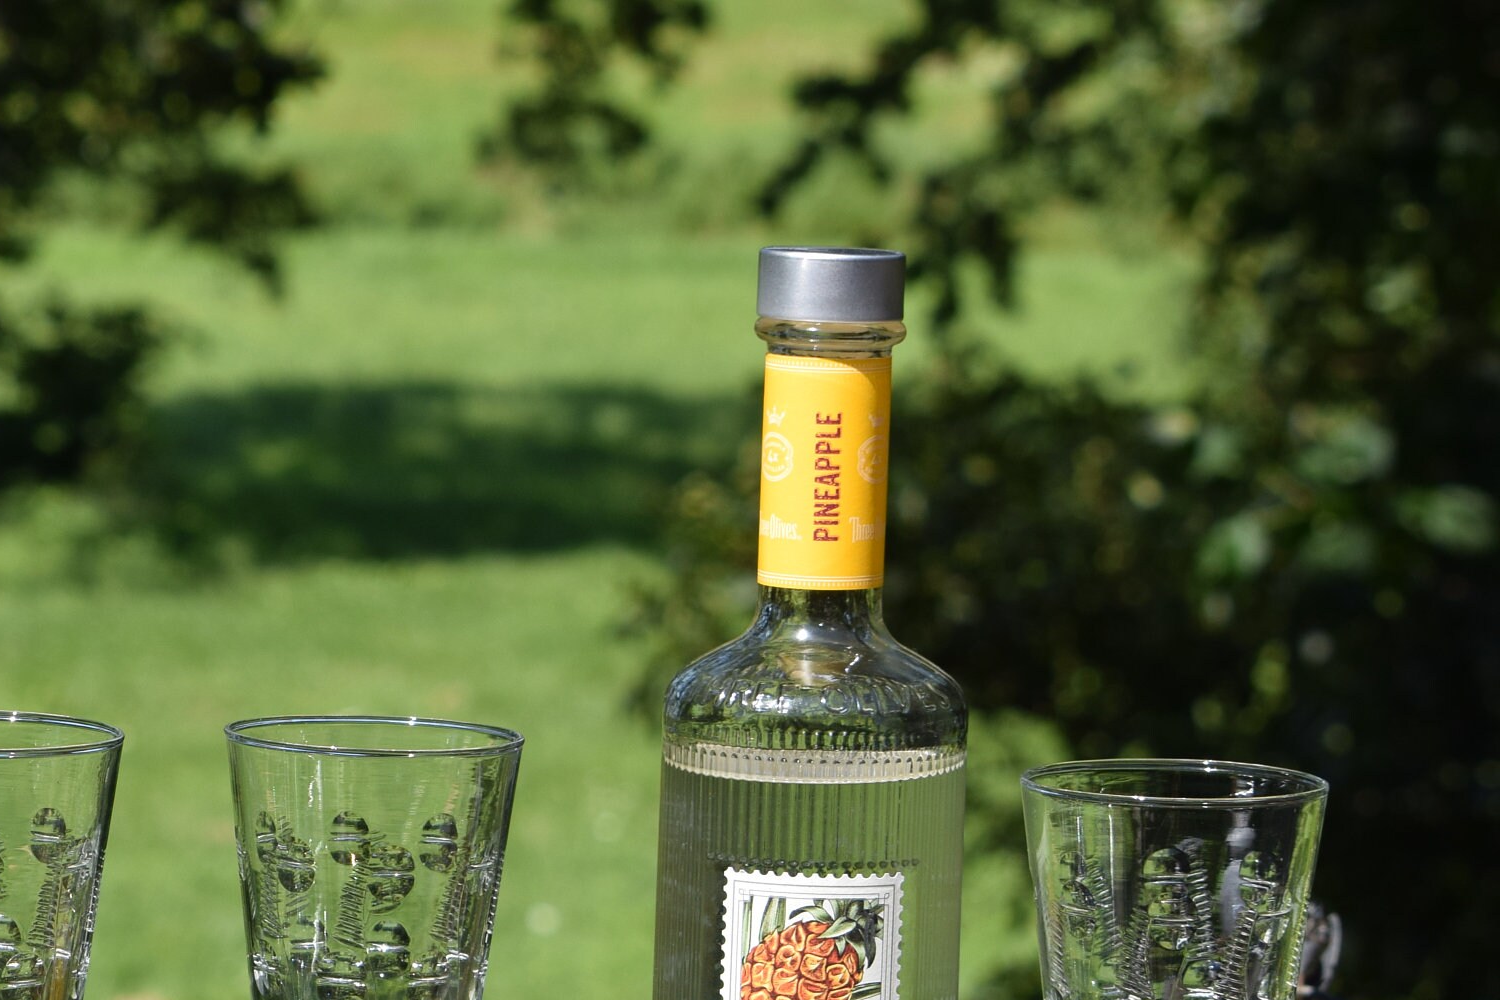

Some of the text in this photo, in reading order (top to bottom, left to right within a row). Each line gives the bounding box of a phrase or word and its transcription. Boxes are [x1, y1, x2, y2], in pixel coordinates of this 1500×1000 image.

[812, 411, 843, 542] PINEAPPLE
[769, 513, 798, 541] Olives
[848, 516, 875, 543] Three
